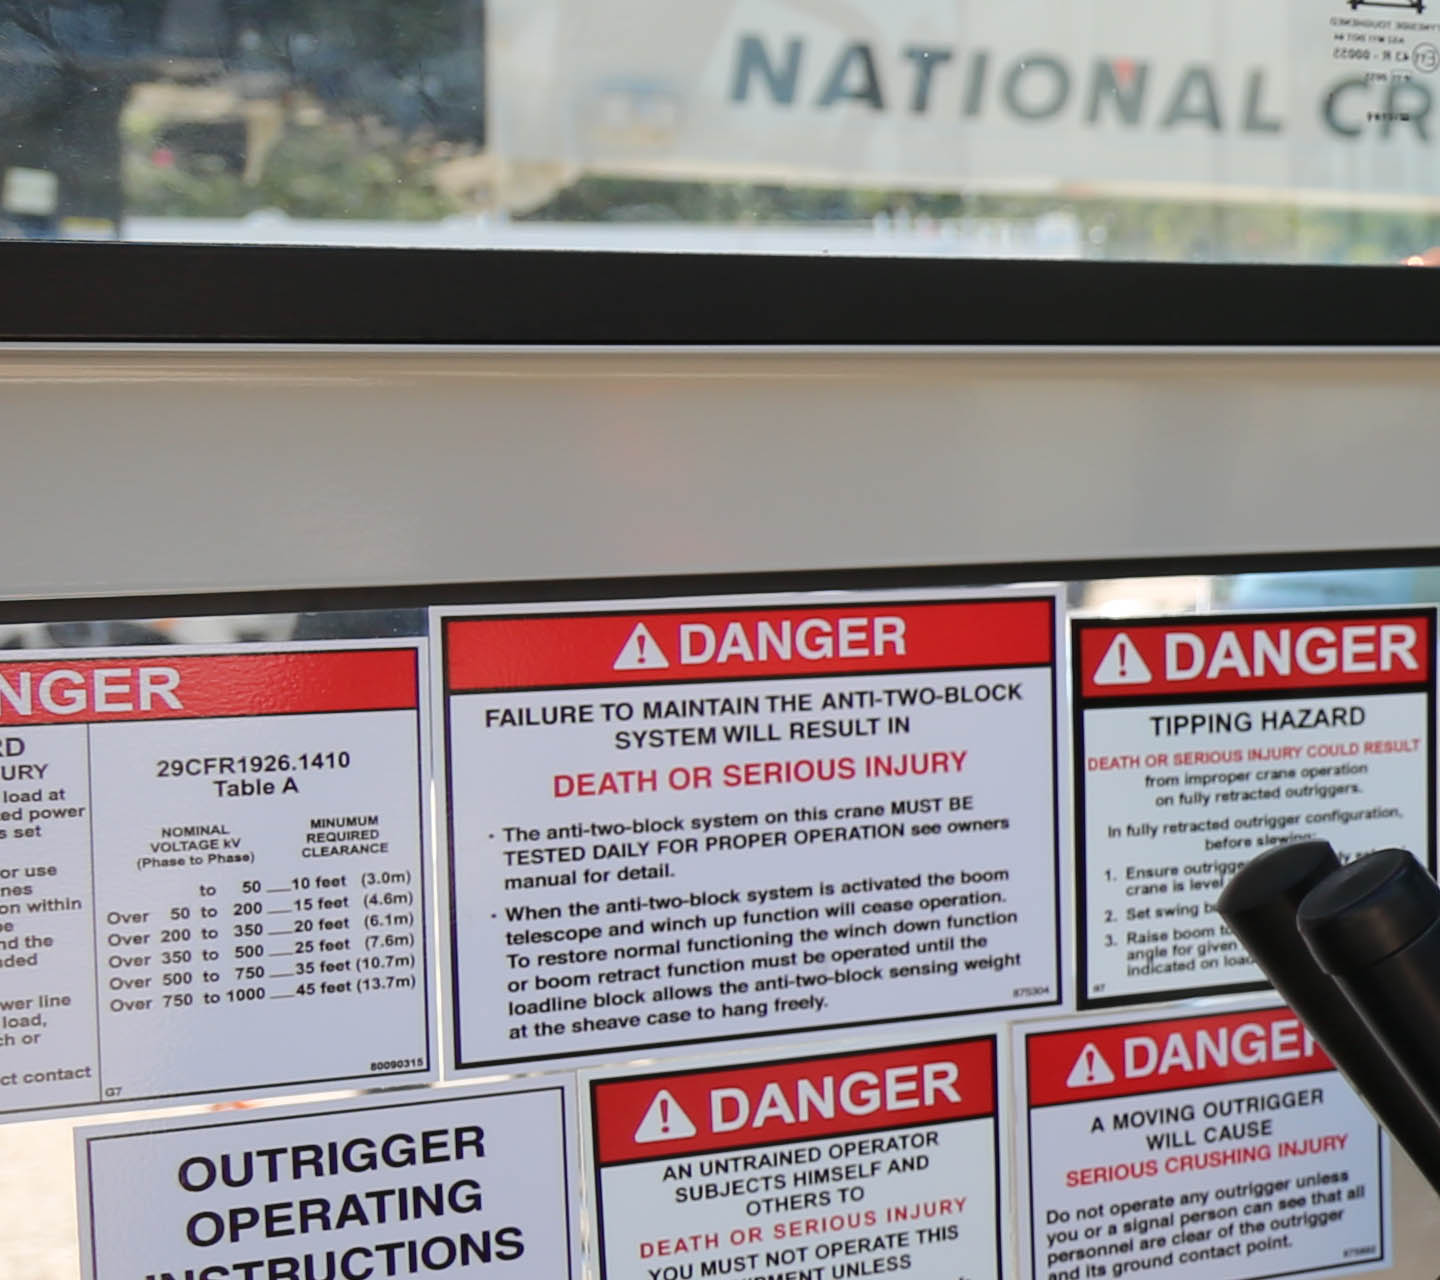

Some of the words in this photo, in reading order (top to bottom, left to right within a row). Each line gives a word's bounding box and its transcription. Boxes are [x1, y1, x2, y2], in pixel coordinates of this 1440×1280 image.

[730, 32, 1282, 135] NATIONAL
[679, 616, 908, 665] DANGER
[1165, 624, 1419, 681] DANGER
[485, 703, 594, 728] FAILURE
[599, 701, 634, 722] TO
[642, 695, 759, 719] MAINTAIN
[764, 693, 812, 713] THE
[821, 683, 1022, 710] ANTI-TWO-BLOCK
[1149, 711, 1252, 737] TIPPING
[1261, 705, 1365, 731] HAZARD
[614, 726, 716, 750] SYSTEM
[722, 723, 781, 743] WILL
[789, 717, 880, 740] RESULT
[887, 716, 910, 734] IN
[156, 750, 350, 777] 29CFR1926.1410
[1087, 754, 1140, 771] DEATH
[1144, 752, 1168, 768] OR
[1172, 748, 1243, 766] SERIOUS
[1246, 745, 1302, 761] INJURY
[1306, 741, 1359, 758] COULD
[1363, 737, 1420, 754] RESULT
[212, 777, 275, 797] Table
[281, 776, 299, 794] A
[553, 768, 657, 798] DEATH
[668, 765, 712, 791] OR
[722, 756, 856, 787] SERIOUS
[865, 750, 967, 778] INJURY
[161, 824, 230, 838] NOMINAL
[305, 828, 380, 844] REQUIRED
[309, 815, 378, 829] MINUMUM
[502, 826, 541, 842] The
[546, 815, 684, 840] anti-two-block
[690, 813, 759, 833] system
[764, 811, 788, 825] on
[793, 806, 828, 822] this
[833, 804, 885, 820] crane
[890, 797, 942, 815] MUST
[948, 795, 973, 811] BE
[136, 857, 185, 870] (Phase
[188, 855, 204, 865] to
[207, 851, 255, 864] Phase)
[149, 838, 219, 853] VOLTAGE
[222, 837, 241, 849] kV
[301, 842, 388, 858] CLEARANCE
[198, 884, 217, 897] to
[241, 879, 262, 894] 50
[291, 876, 310, 890] 10
[314, 874, 346, 889] feet
[360, 870, 411, 888] (3.0m)
[109, 998, 152, 1012] Over
[162, 992, 193, 1007] 750
[202, 992, 221, 1005] to
[225, 986, 266, 1002] 1000
[295, 982, 316, 996] 45
[319, 980, 351, 994] feet
[355, 974, 416, 993] (13.7m)
[710, 1062, 961, 1133] DANGER
[1090, 1115, 1105, 1133] A
[1112, 1103, 1195, 1130] MOVING
[1202, 1087, 1324, 1119] OUTRIGGER
[1145, 1129, 1196, 1151] WILL
[1203, 1118, 1272, 1144] CAUSE
[177, 1124, 485, 1192] OUTRIGGER
[662, 1162, 692, 1181] AN
[698, 1146, 822, 1177] UNTRAINED
[827, 1130, 938, 1160] OPERATOR
[1065, 1158, 1159, 1188] SERIOUS
[1164, 1143, 1272, 1174] CRUSHING
[1277, 1133, 1348, 1158] INJURY
[675, 1173, 786, 1203] SUBJECTS
[792, 1160, 881, 1187] HIMSELF
[887, 1154, 929, 1174] AND
[185, 1178, 482, 1247] OPERATING
[745, 1190, 831, 1216] OTHERS
[837, 1185, 865, 1203] TO
[639, 1232, 719, 1259] DEATH
[729, 1226, 762, 1246] OR
[773, 1209, 877, 1240] SERIOUS
[886, 1197, 966, 1223] INJURY
[700, 1253, 759, 1277] MUST
[765, 1246, 808, 1267] NOT
[814, 1231, 909, 1260] OPERATE
[915, 1224, 959, 1244] THIS
[831, 1253, 911, 1280] UNLESS
